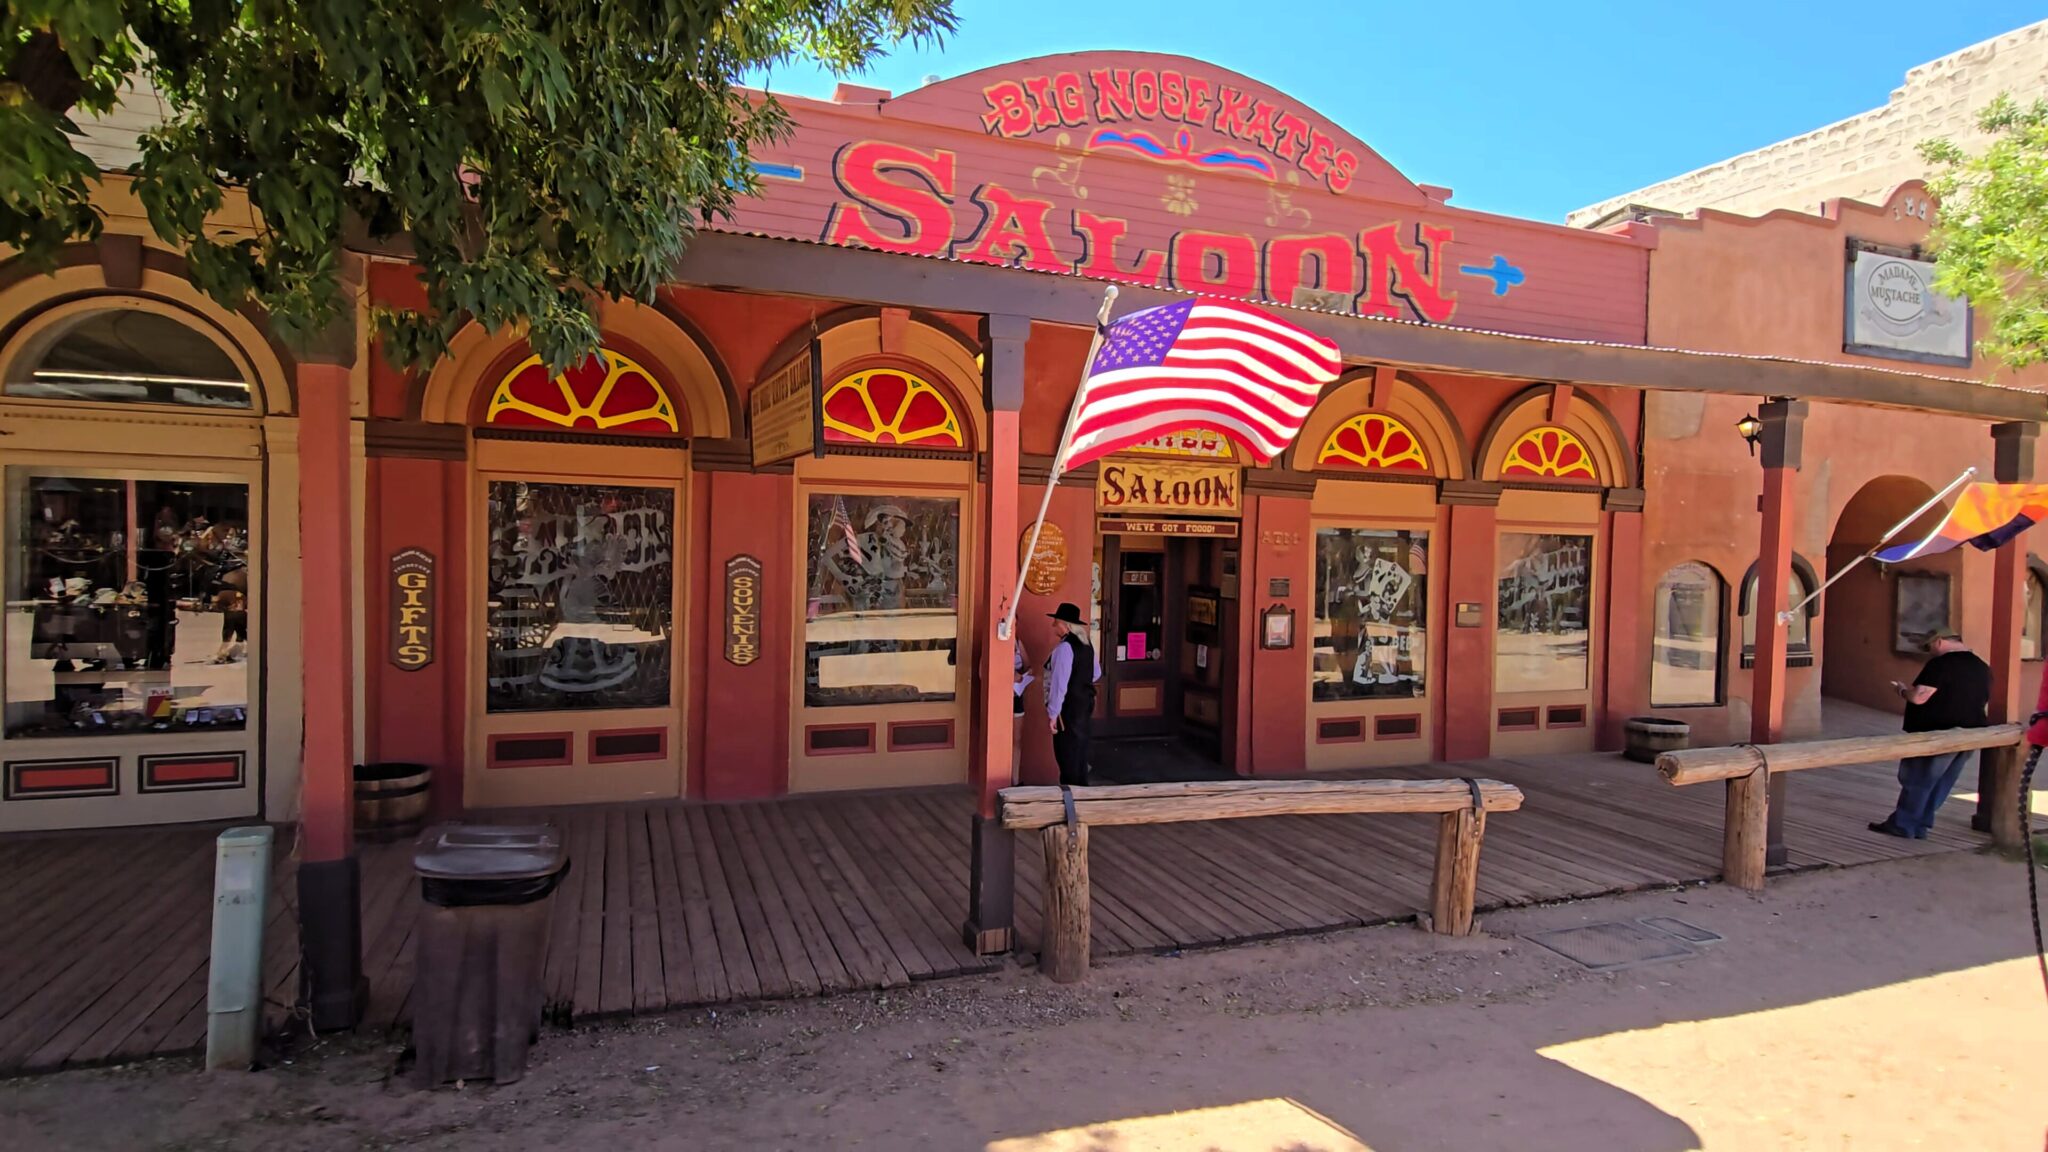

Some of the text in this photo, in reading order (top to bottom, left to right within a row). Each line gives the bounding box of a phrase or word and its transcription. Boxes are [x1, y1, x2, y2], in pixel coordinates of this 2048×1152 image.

[980, 67, 1358, 195] BIG NOSE KATES
[819, 139, 1458, 325] SALOON
[1871, 285, 1921, 308] MUSTACHE
[1877, 266, 1919, 292] MADAME
[1102, 466, 1236, 508] SALOON
[1161, 523, 1179, 533] GOT
[1131, 573, 1148, 582] OPEN
[397, 572, 428, 664] GIFTS
[732, 576, 755, 665] SOUVENIRS
